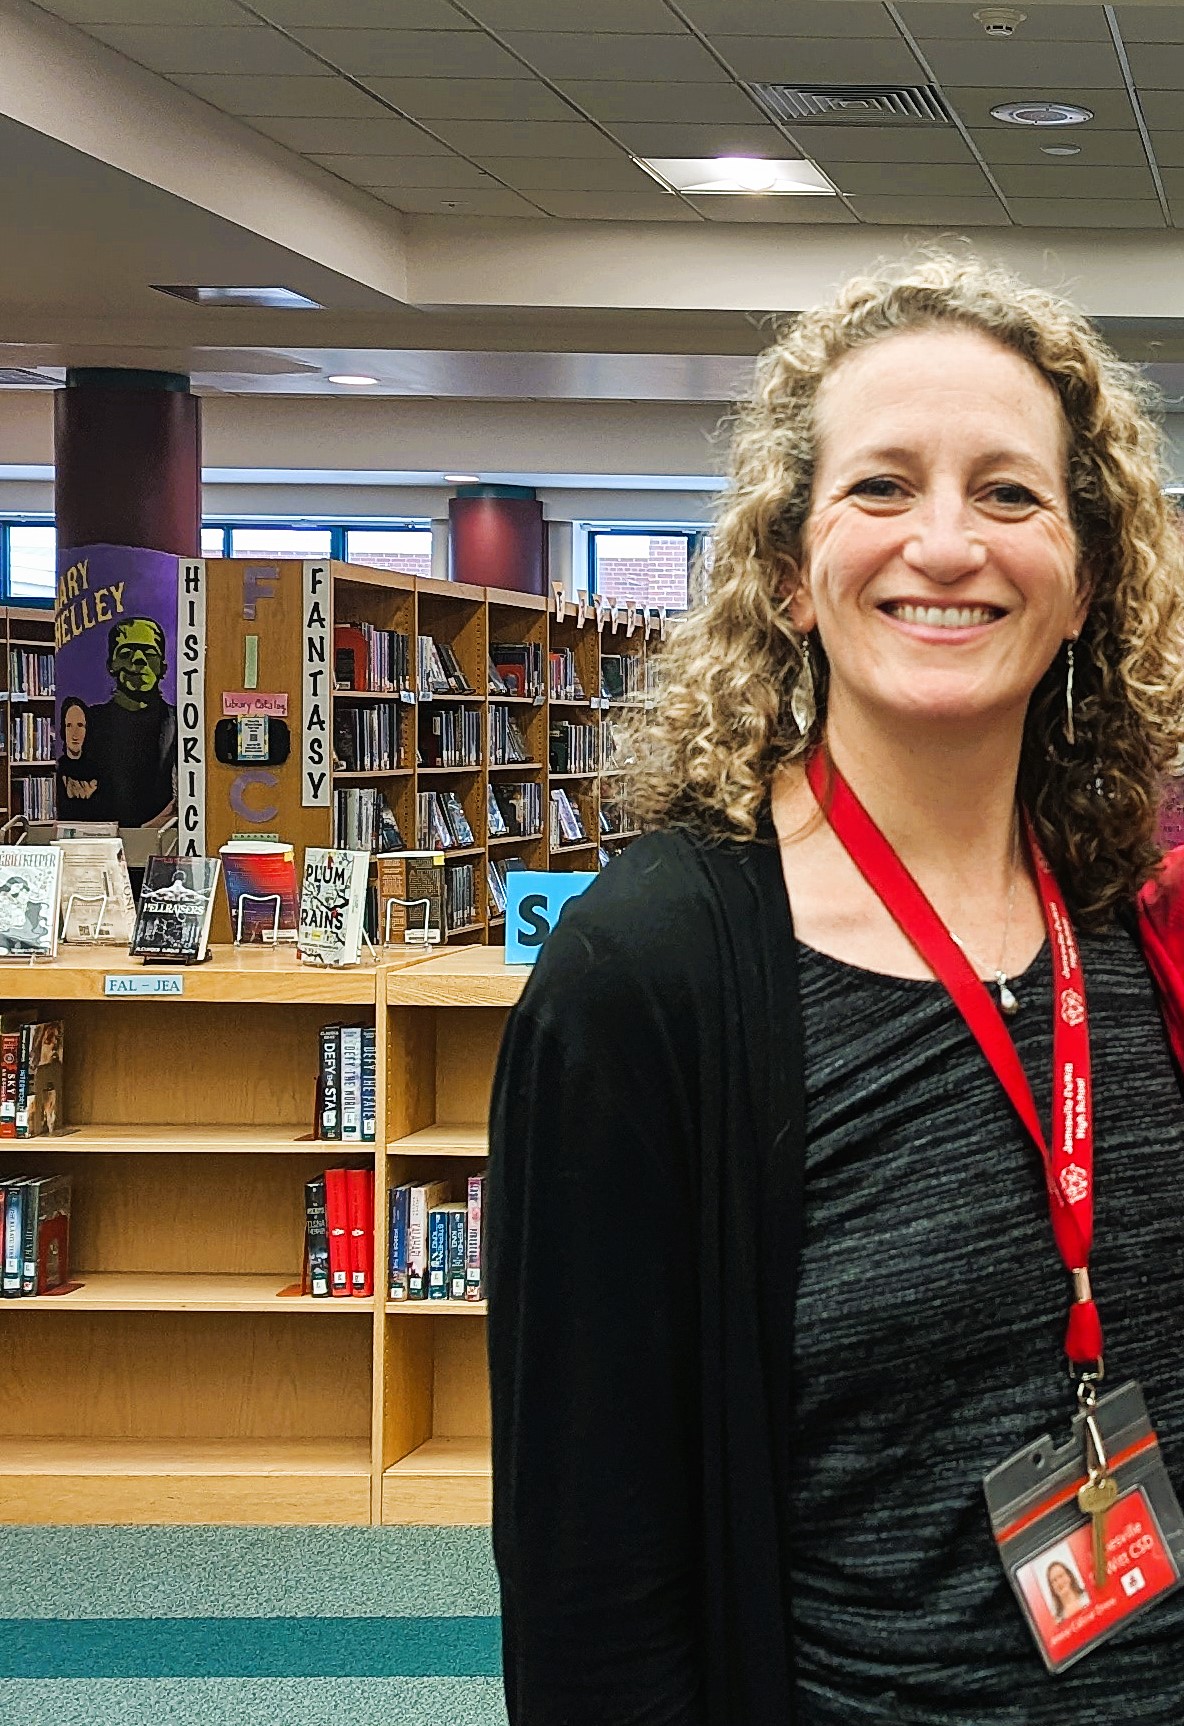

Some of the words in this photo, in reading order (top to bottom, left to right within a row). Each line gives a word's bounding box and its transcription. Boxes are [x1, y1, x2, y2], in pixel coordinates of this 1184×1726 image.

[58, 559, 88, 610] ARY
[306, 568, 326, 799] FANTASY
[183, 566, 202, 857] HISTORICA
[306, 863, 345, 886] PLUM
[300, 908, 344, 931] RAINS
[109, 979, 138, 992] FAL
[153, 979, 180, 992] JEA
[324, 1042, 337, 1075] DEFY
[343, 1045, 356, 1067] DEFY
[7, 1073, 17, 1096] SKY
